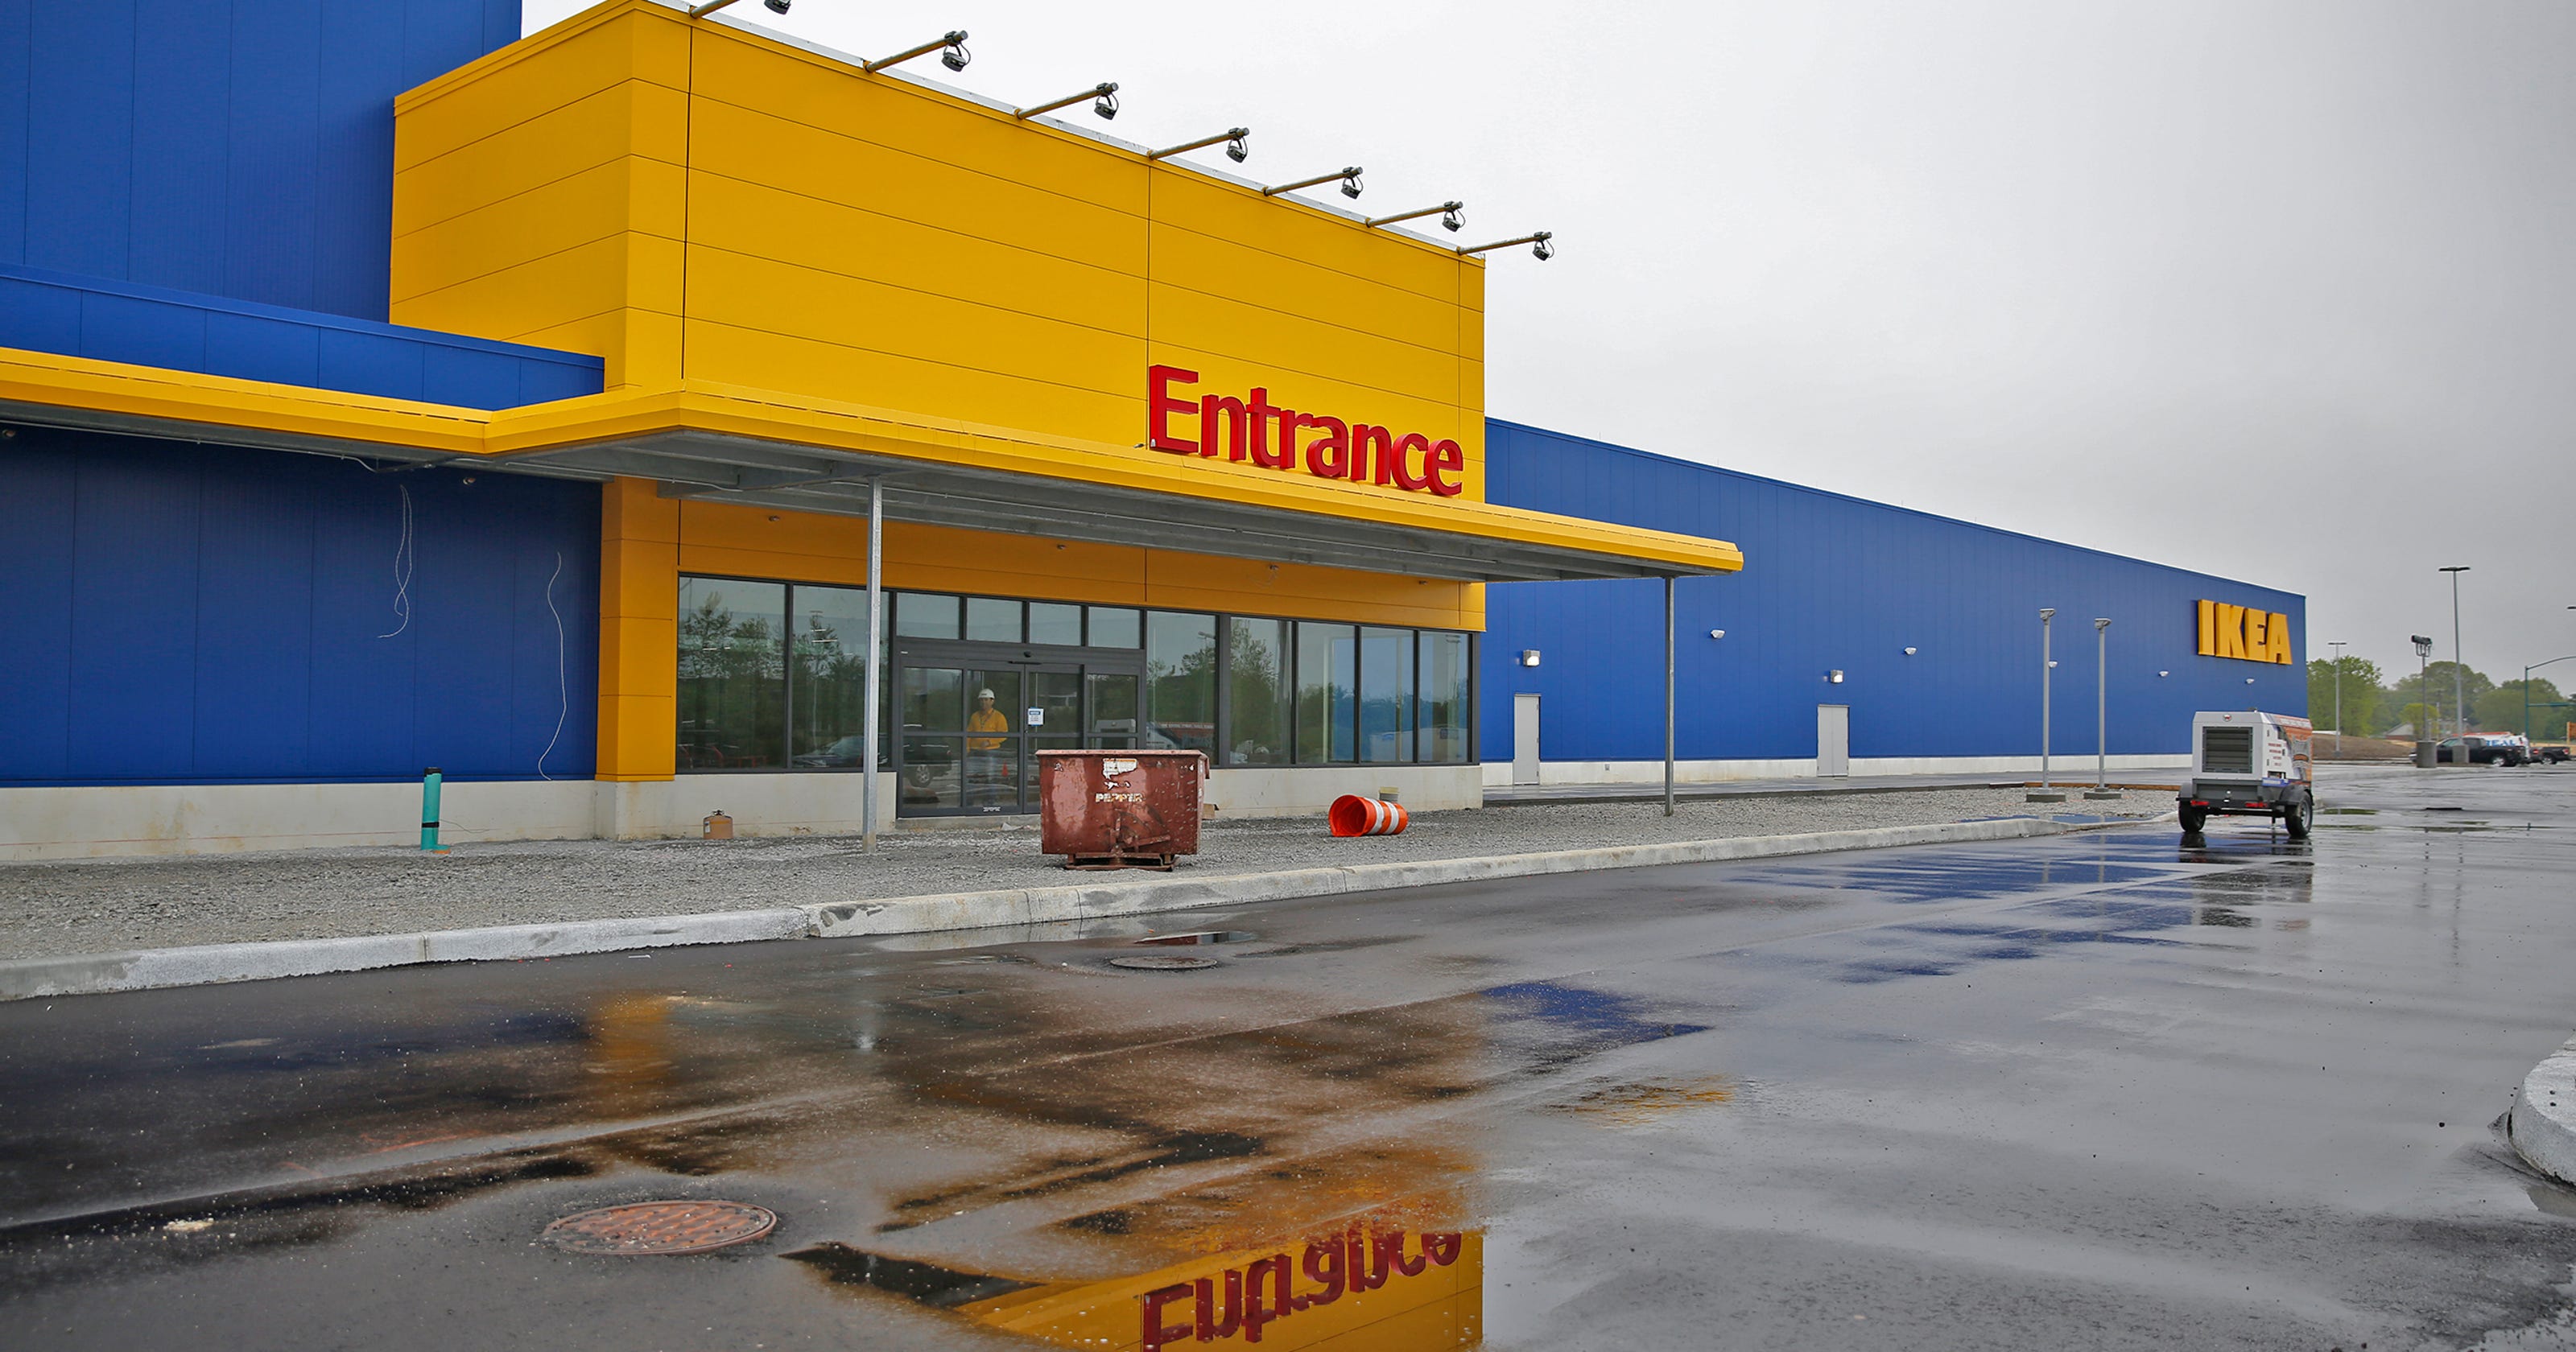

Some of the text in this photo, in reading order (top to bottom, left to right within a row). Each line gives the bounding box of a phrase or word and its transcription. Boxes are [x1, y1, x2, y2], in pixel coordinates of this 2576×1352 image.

[1150, 365, 1463, 495] Entrance
[2198, 600, 2293, 665] IKEA
[1096, 793, 1143, 802] PEPPER
